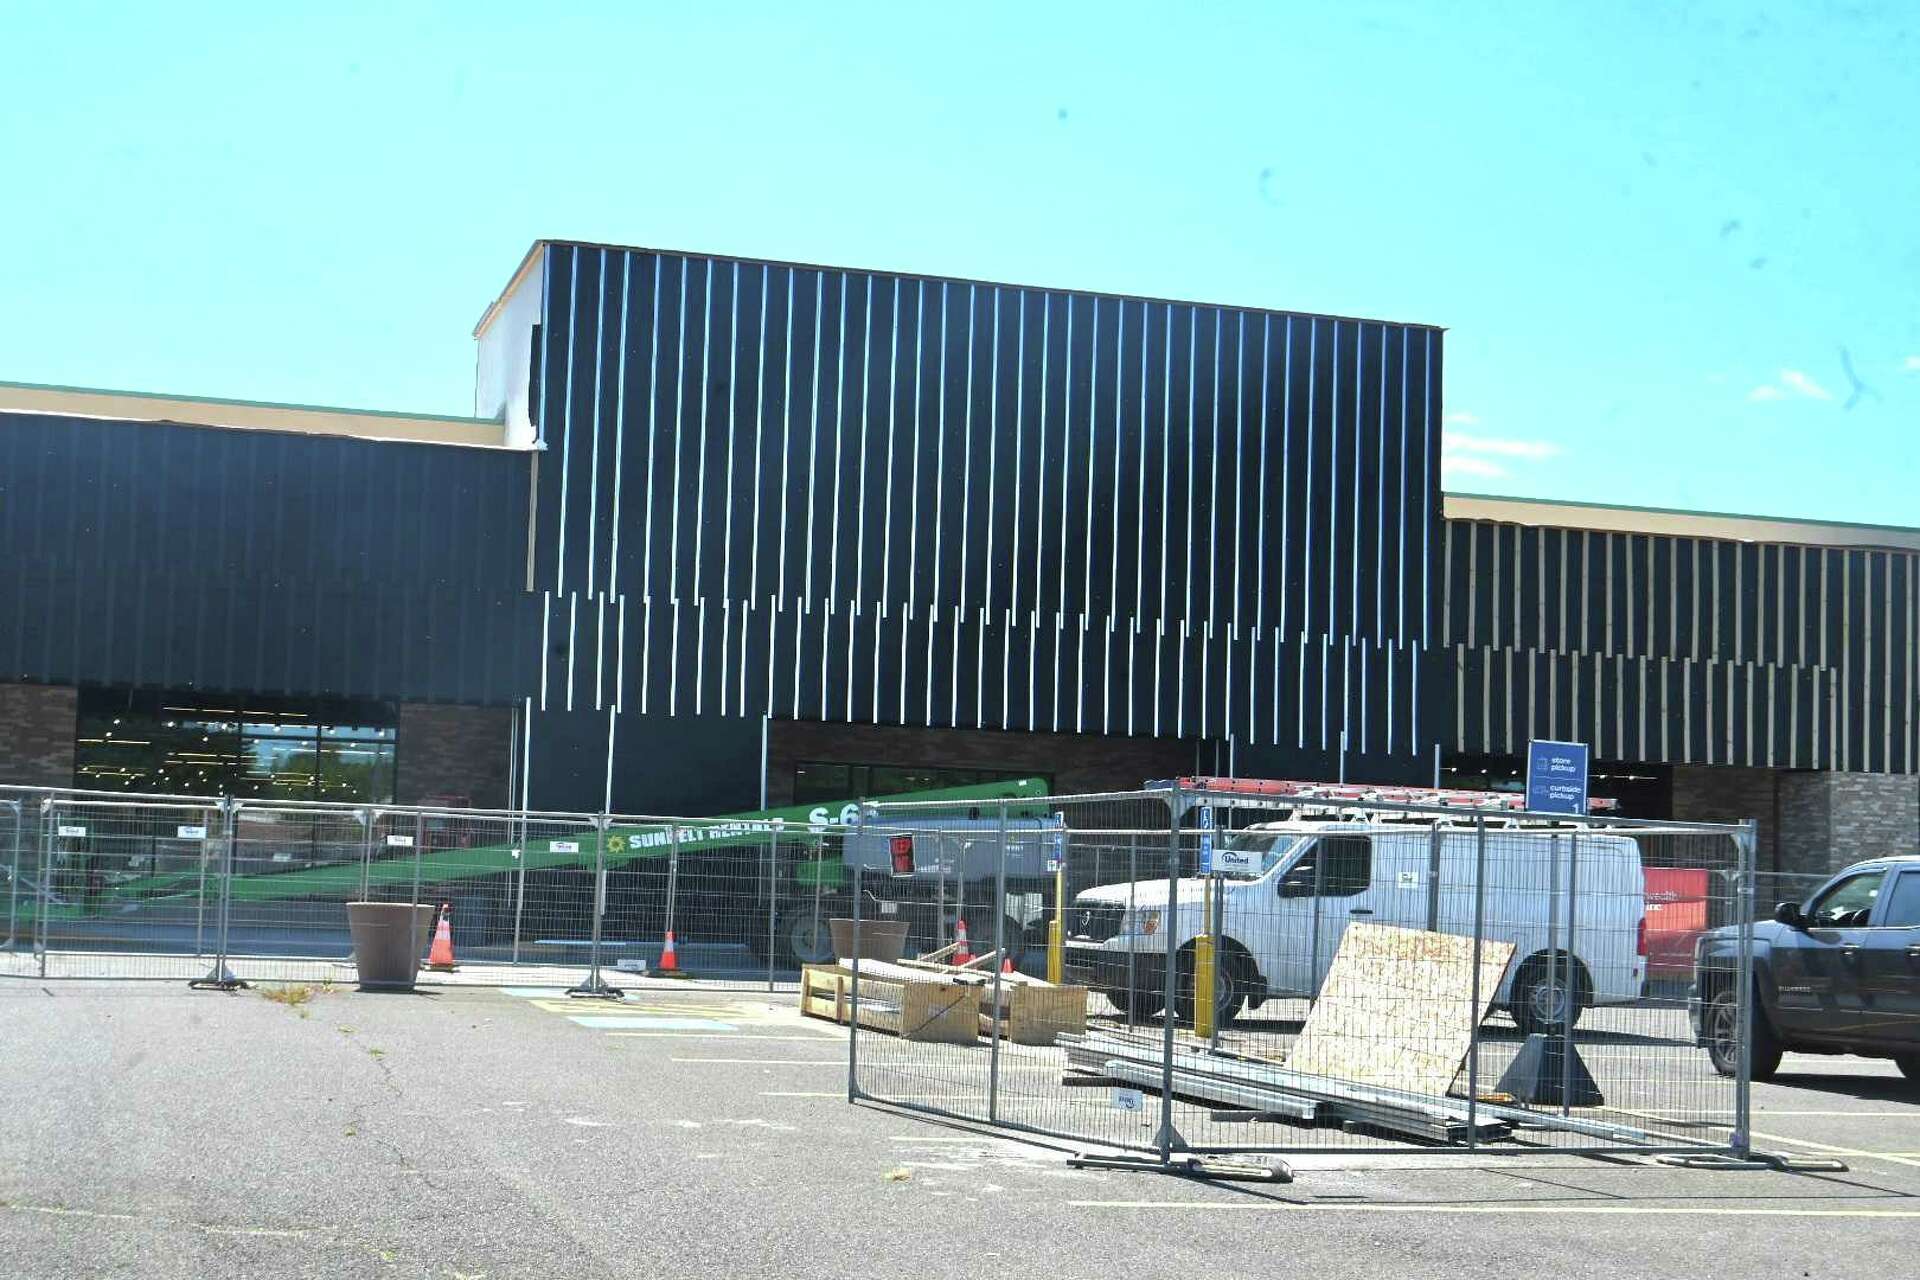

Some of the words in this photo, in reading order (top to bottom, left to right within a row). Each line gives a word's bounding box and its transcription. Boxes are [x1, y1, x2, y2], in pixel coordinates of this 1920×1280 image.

[1551, 757, 1571, 765] store
[1551, 764, 1576, 773] pickup
[1549, 785, 1582, 794] curbside
[1549, 792, 1575, 800] pickup
[1571, 803, 1580, 814] 1
[1223, 854, 1249, 865] United
